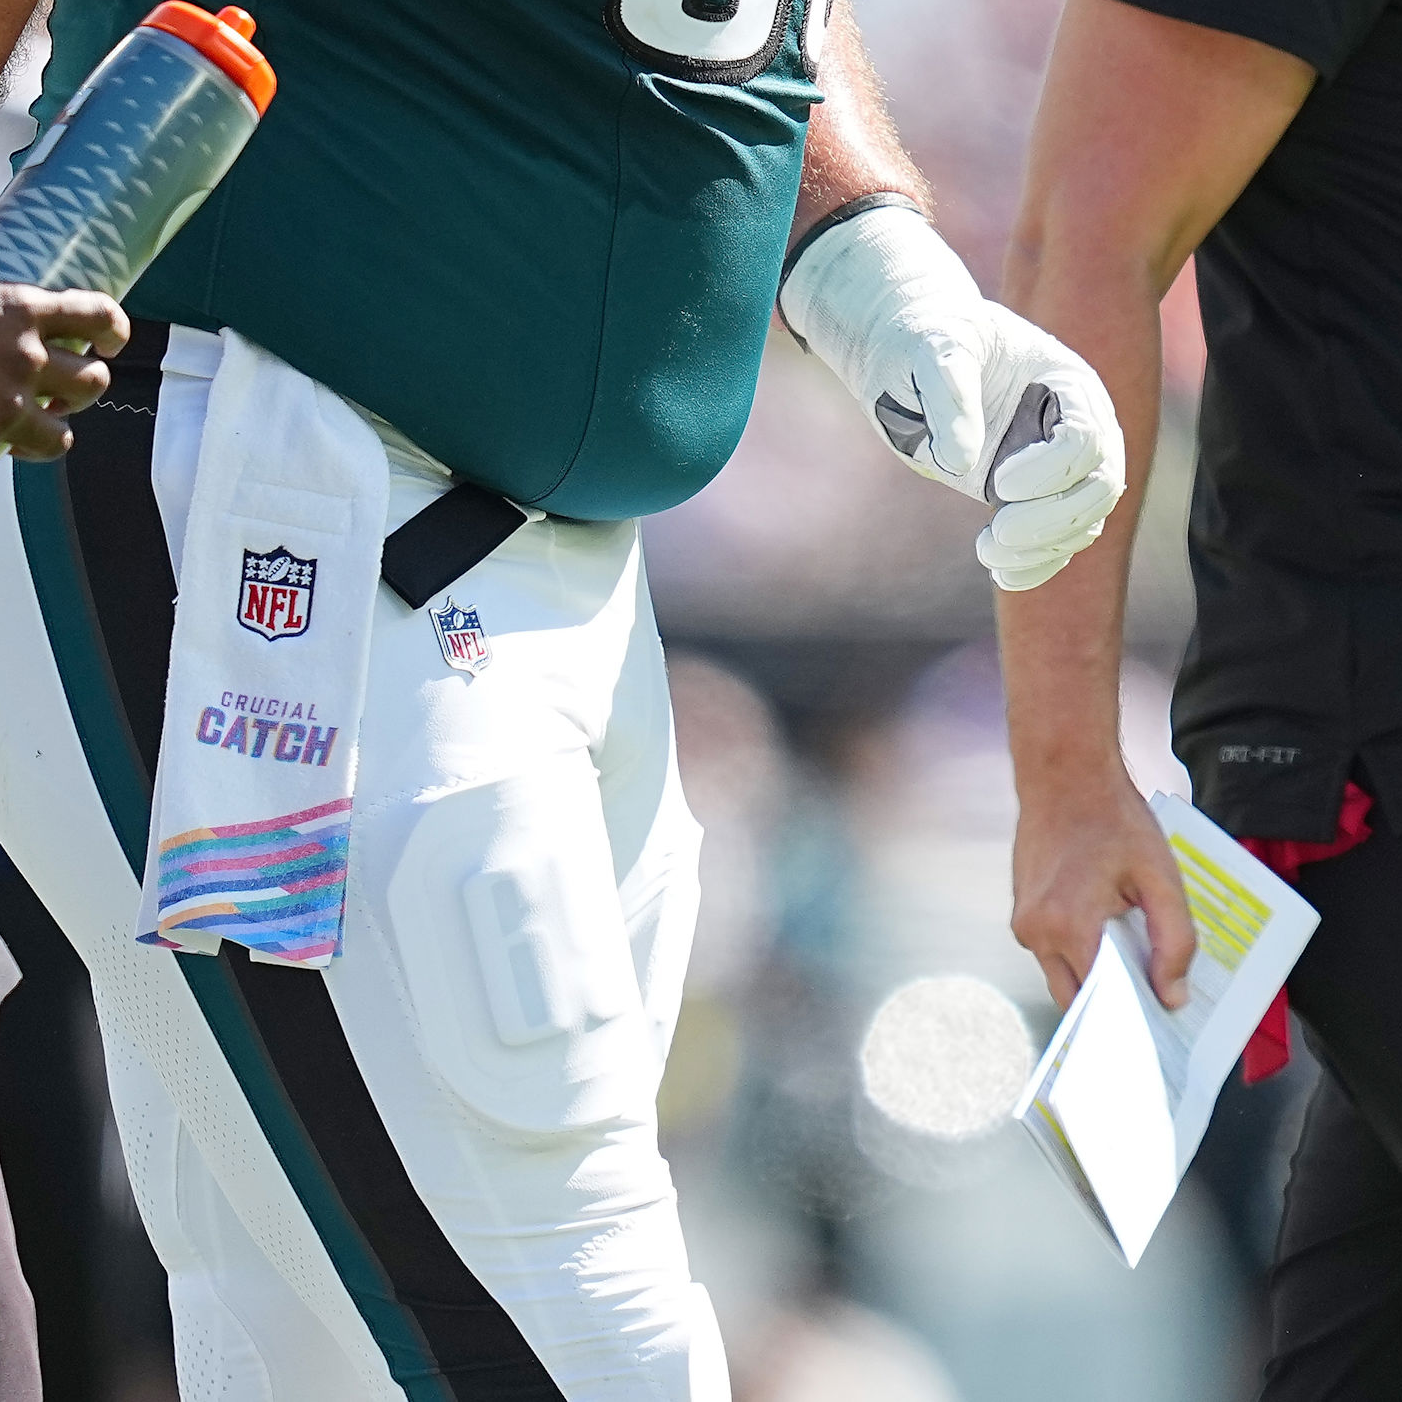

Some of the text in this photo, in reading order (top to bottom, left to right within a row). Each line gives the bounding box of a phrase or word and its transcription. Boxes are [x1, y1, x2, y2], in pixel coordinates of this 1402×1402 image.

[244, 584, 303, 631] NFL
[447, 631, 485, 660] NFL
[221, 691, 317, 721] CRUCIAL
[196, 706, 339, 766] CATCH
